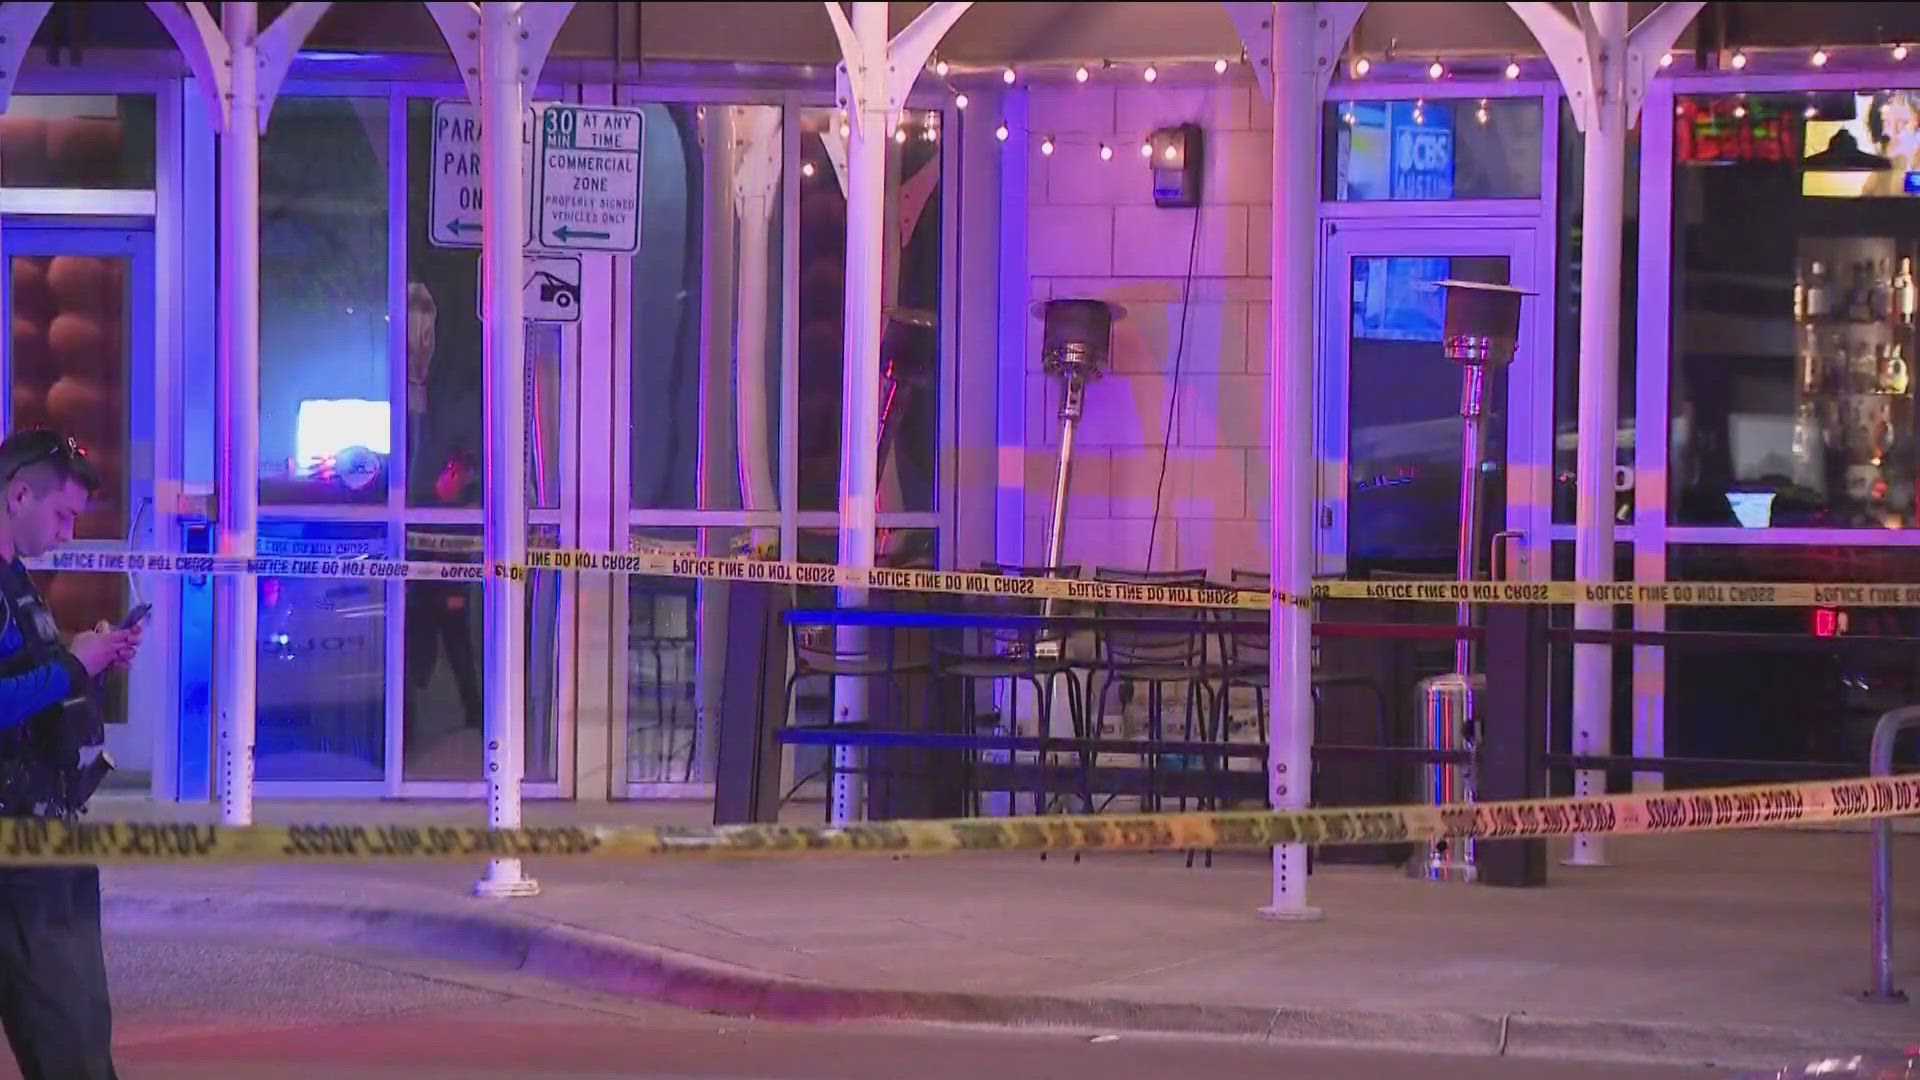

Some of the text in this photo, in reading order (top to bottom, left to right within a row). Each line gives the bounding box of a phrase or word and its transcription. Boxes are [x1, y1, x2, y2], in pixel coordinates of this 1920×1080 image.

[546, 110, 574, 133] 30
[583, 114, 632, 130] AT ANY
[592, 133, 622, 148] TIME
[549, 155, 633, 172] COMMERCIAL
[573, 177, 608, 192] ZONE
[600, 197, 635, 210] SIGNED
[602, 212, 626, 224] ONLY
[1831, 785, 1869, 816] CROSS
[1870, 782, 1893, 813] NOT
[1895, 783, 1911, 811] DO
[1645, 792, 1804, 829] POLICE LINE DO NOT CROSS
